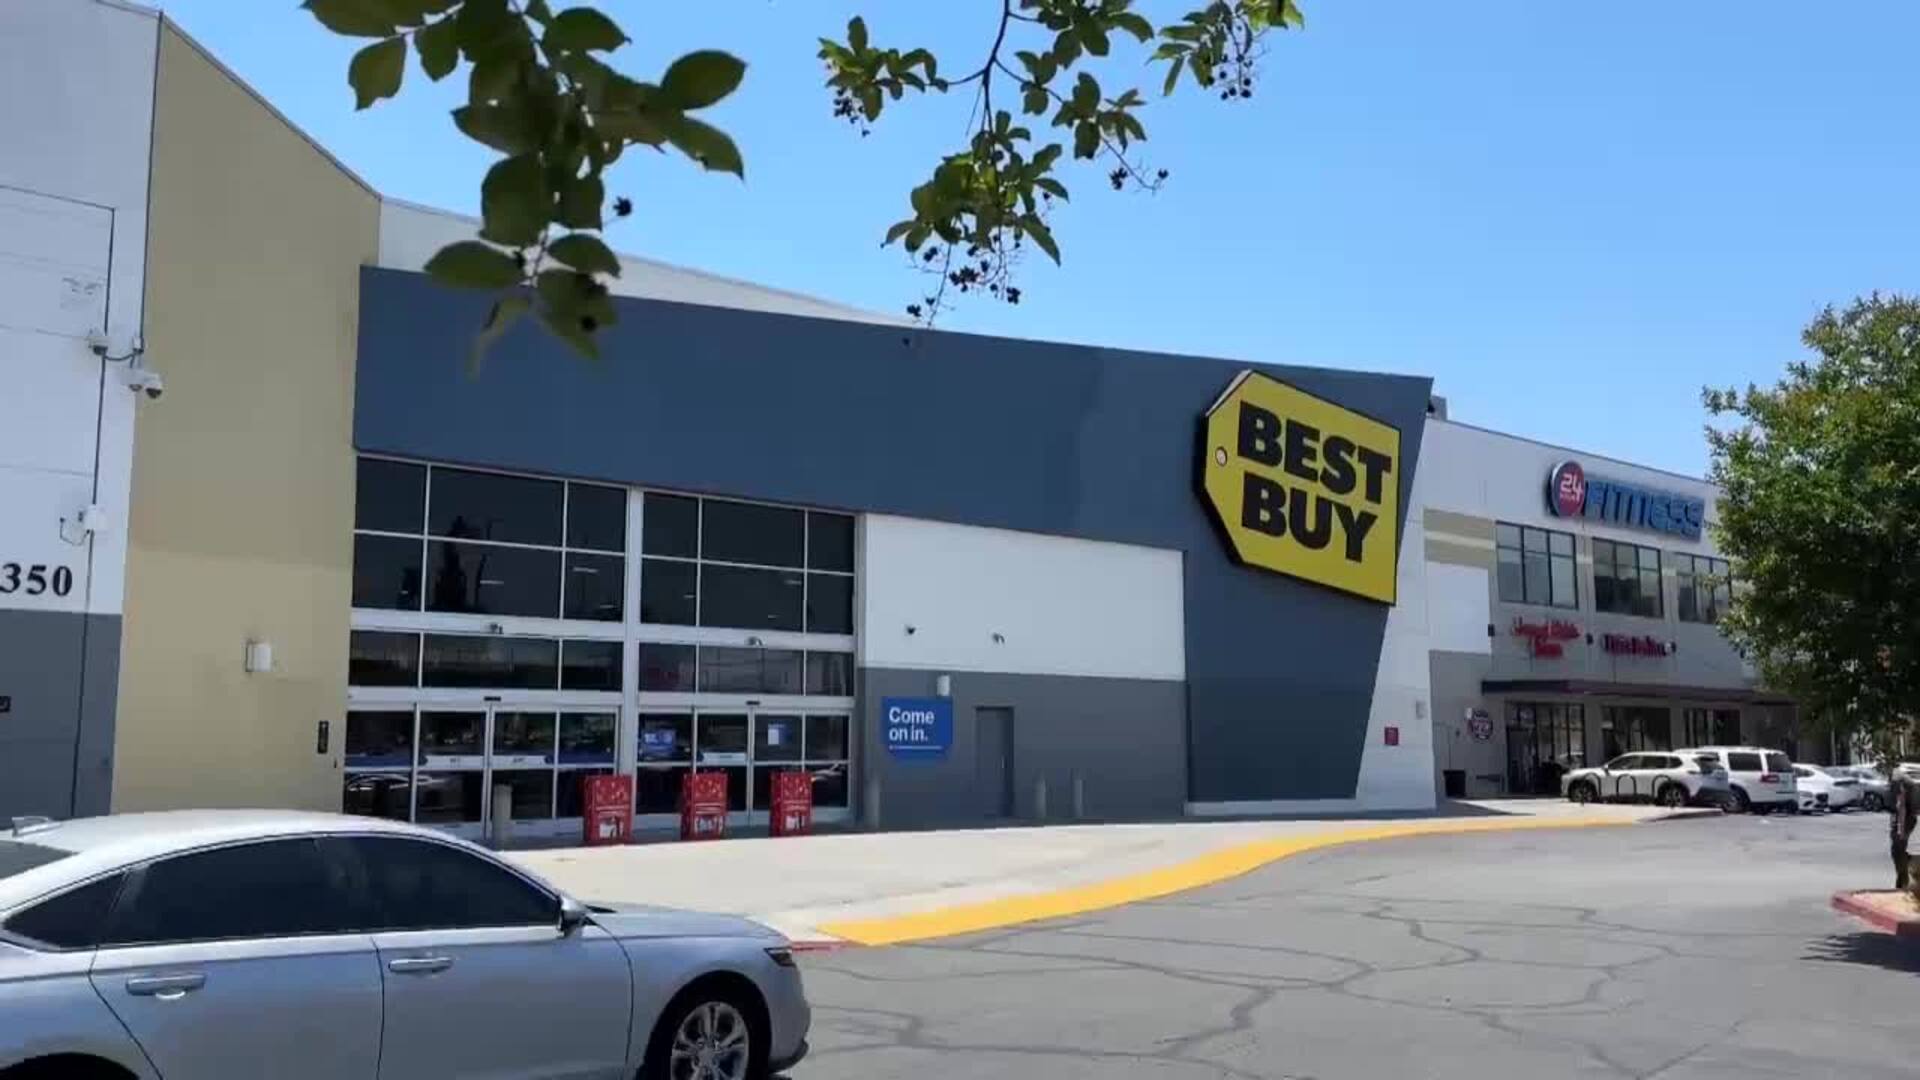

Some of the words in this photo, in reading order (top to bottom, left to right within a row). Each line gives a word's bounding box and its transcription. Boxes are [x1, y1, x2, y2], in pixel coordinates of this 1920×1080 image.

[1237, 400, 1392, 505] BEST
[1560, 472, 1583, 503] 24
[1241, 470, 1378, 563] BUY
[0, 562, 73, 596] 350
[888, 706, 935, 725] Come
[888, 727, 908, 741] on
[911, 724, 929, 741] in.
